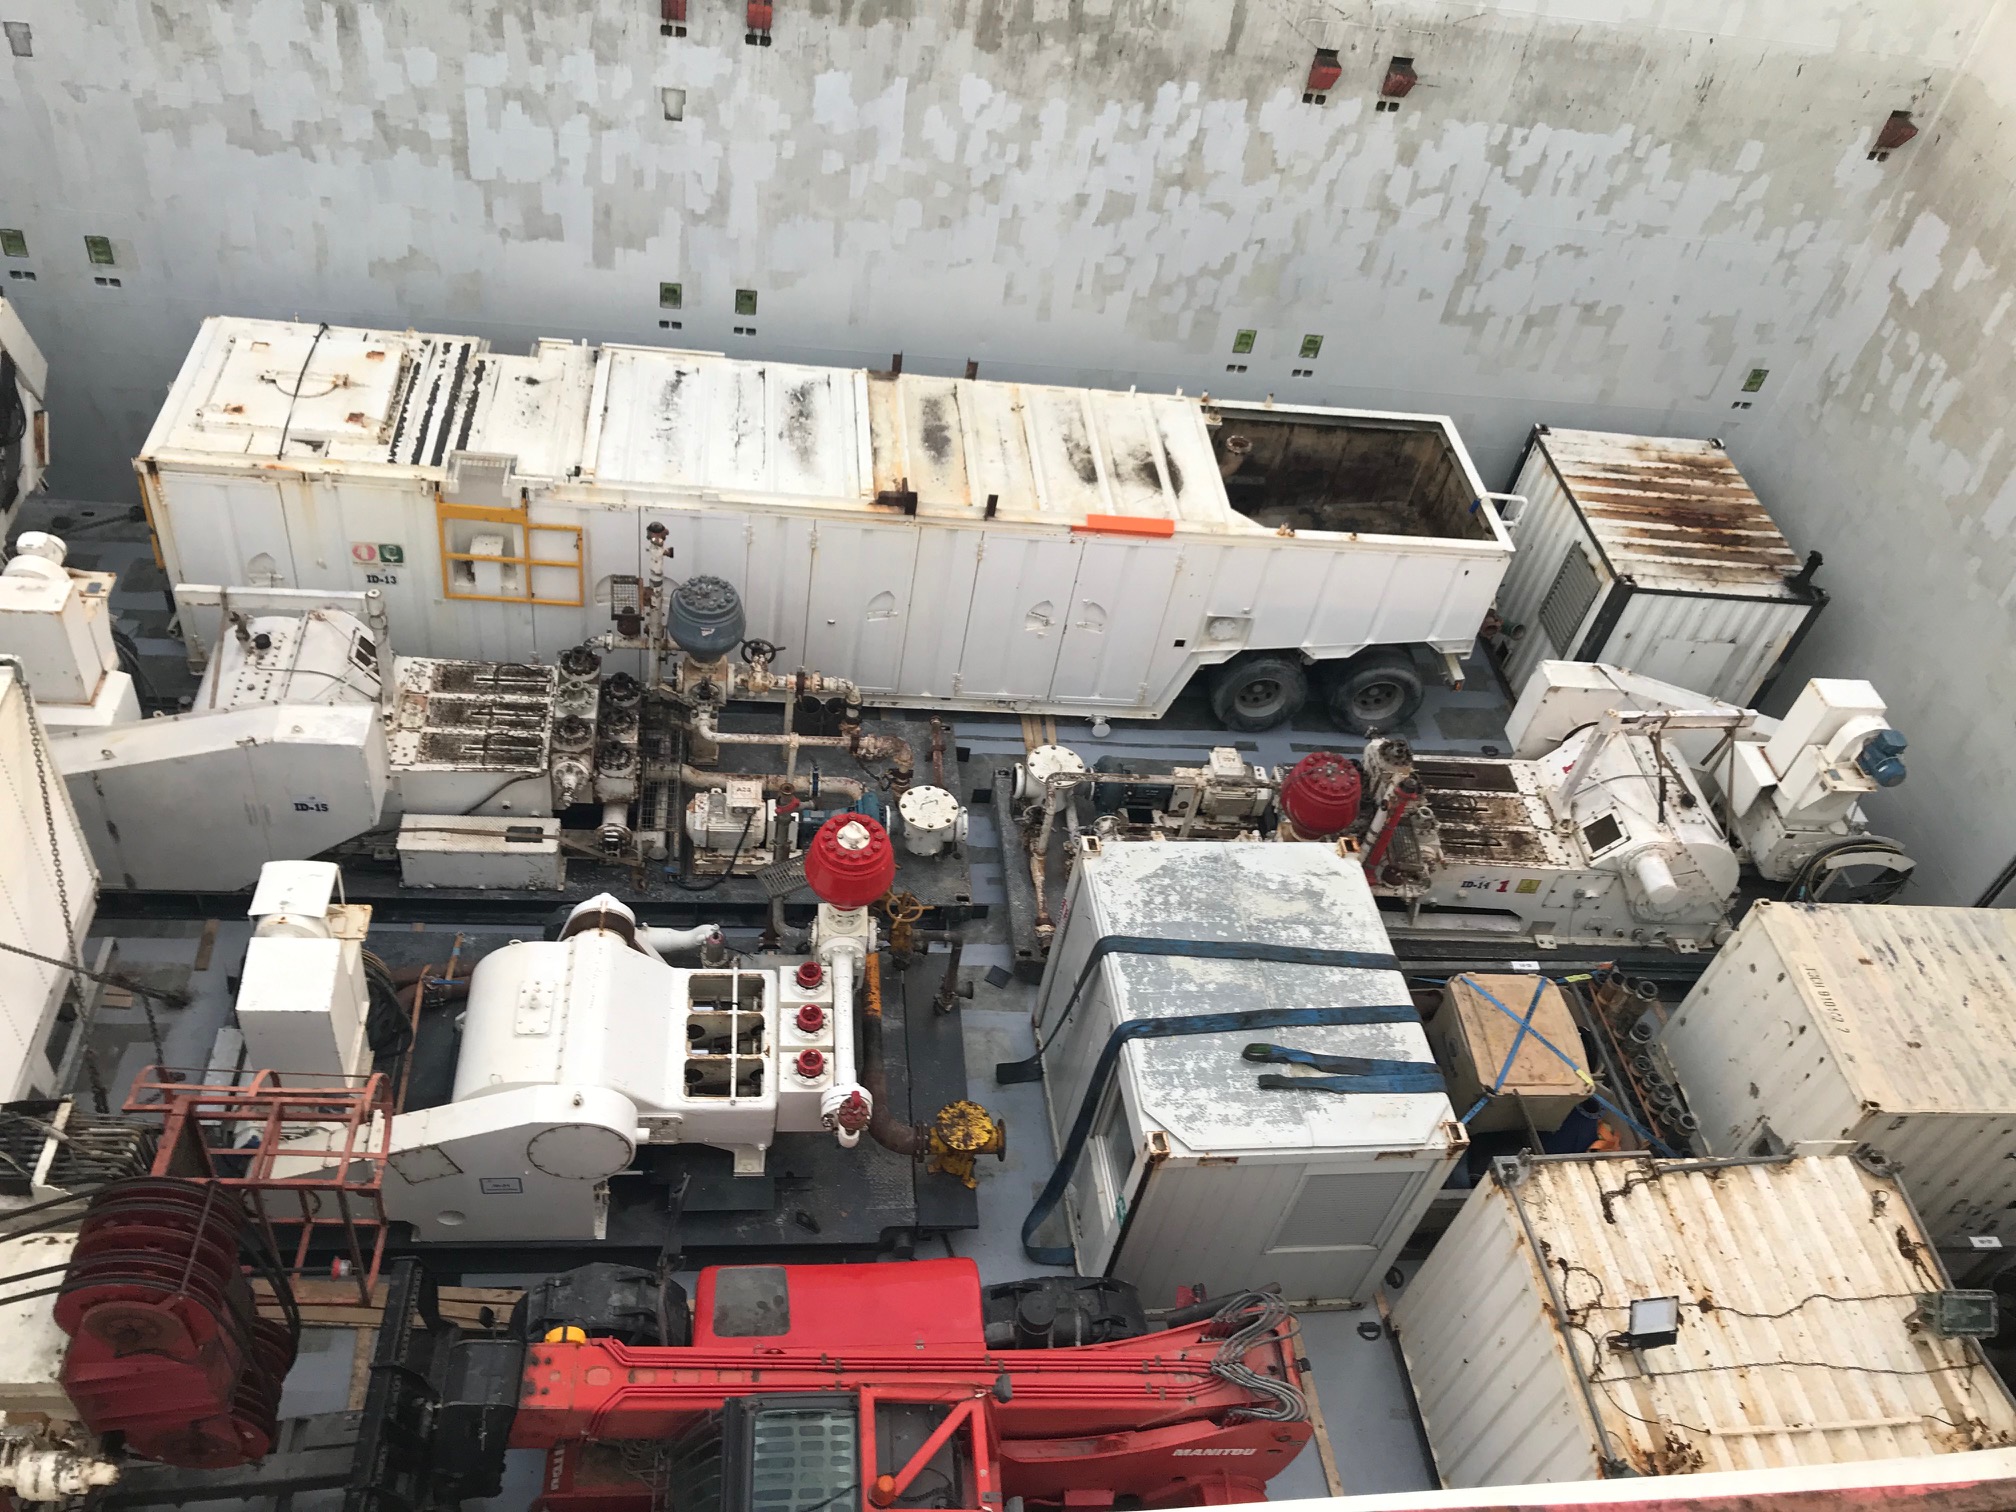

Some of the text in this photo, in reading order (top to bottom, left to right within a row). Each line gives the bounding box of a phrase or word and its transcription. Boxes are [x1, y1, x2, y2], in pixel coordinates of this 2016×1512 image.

[366, 574, 397, 585] ID-13
[293, 802, 329, 812] ID-15
[1461, 880, 1490, 890] ID-14
[1496, 880, 1510, 893] 1
[1173, 1448, 1257, 1457] MANITOU
